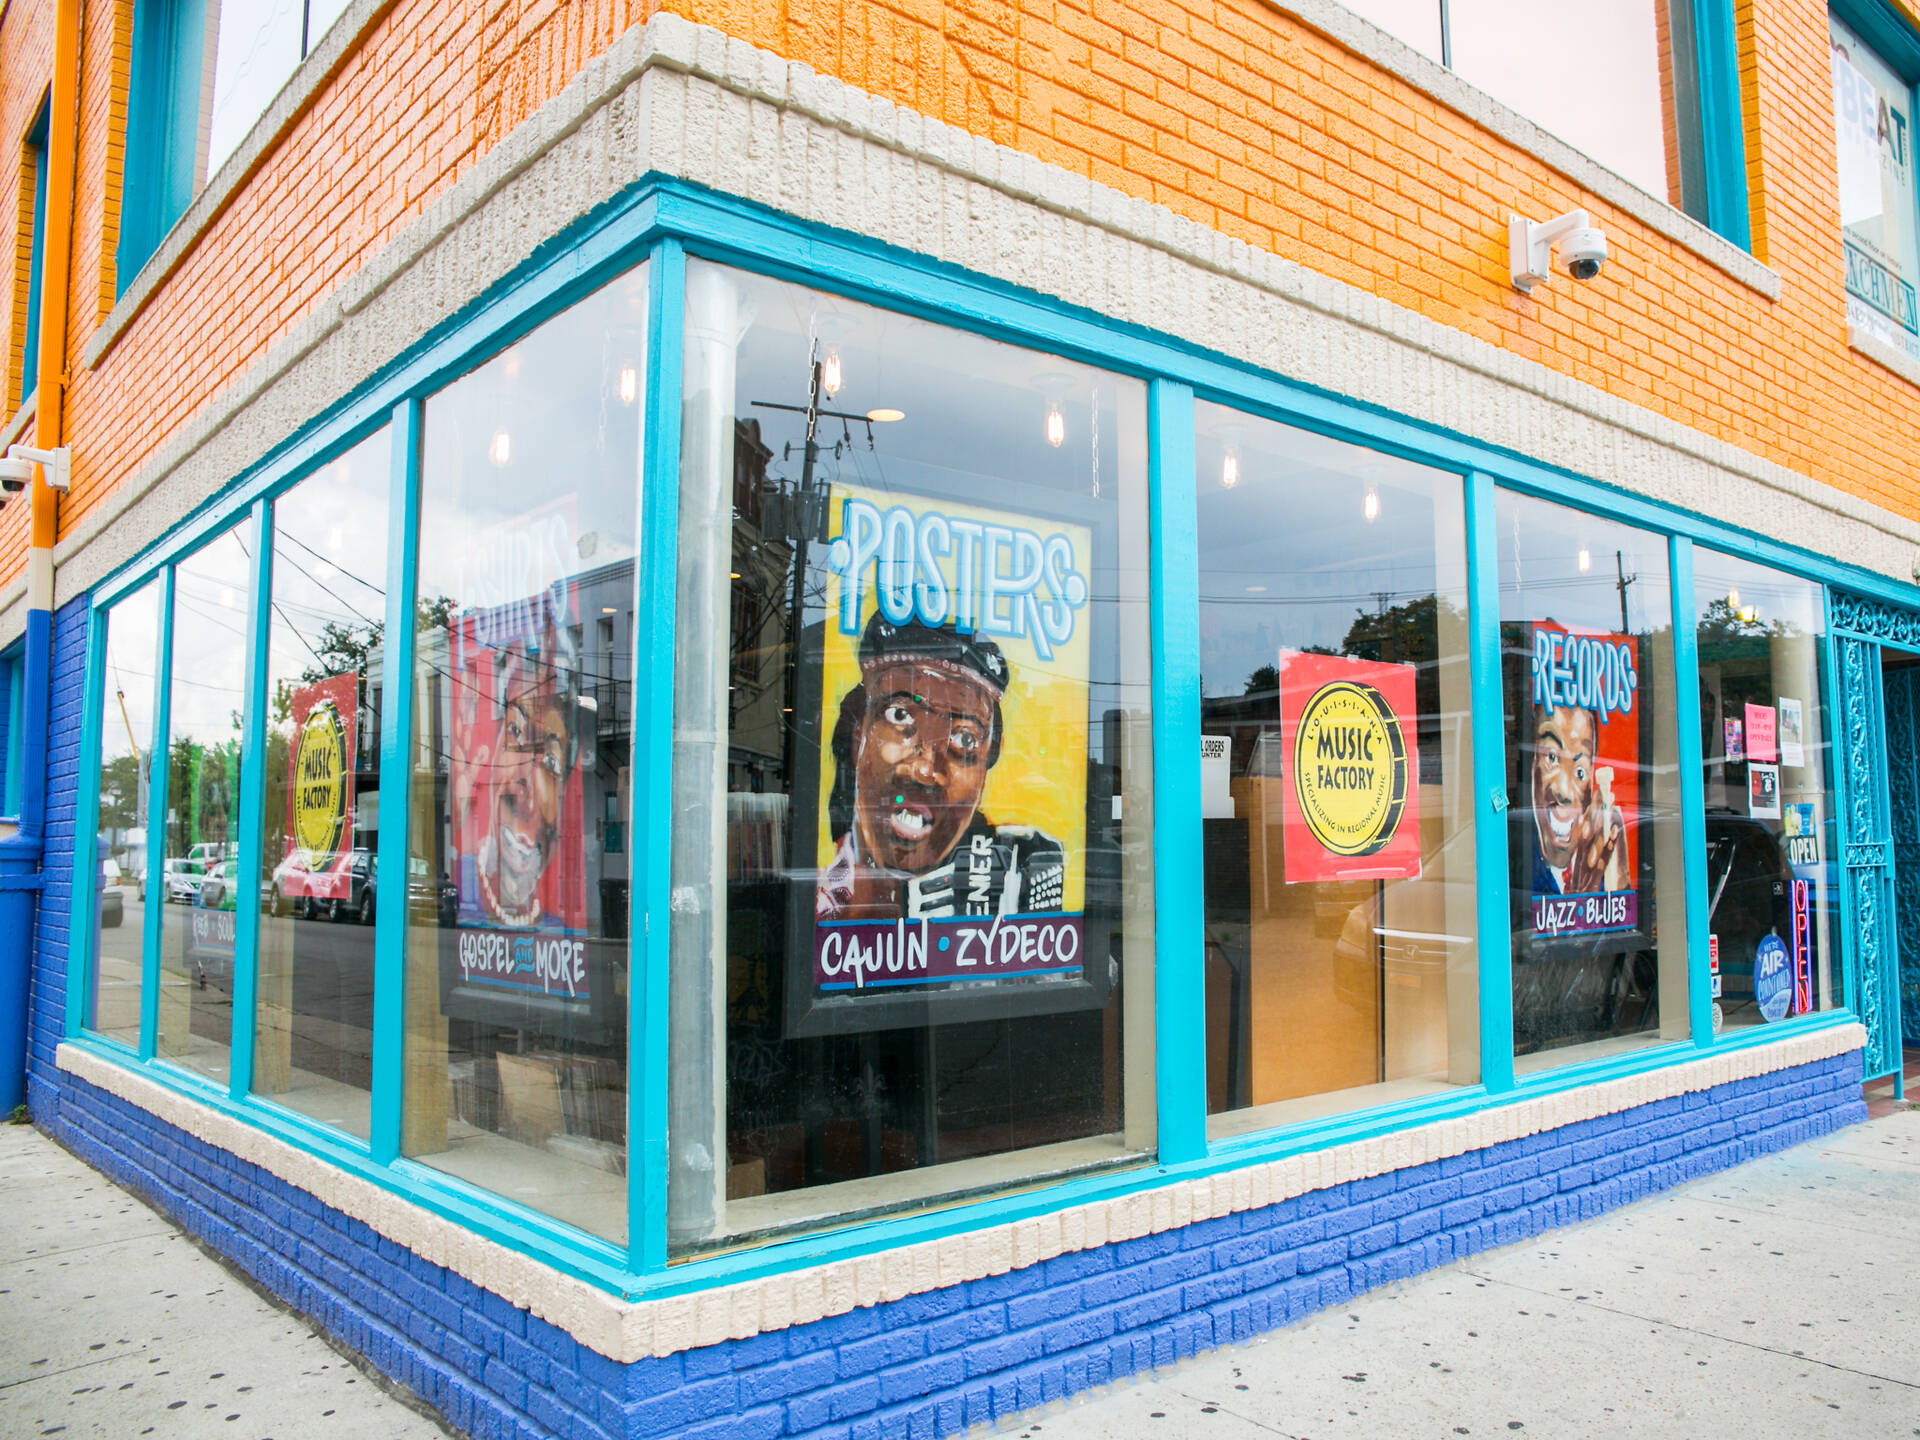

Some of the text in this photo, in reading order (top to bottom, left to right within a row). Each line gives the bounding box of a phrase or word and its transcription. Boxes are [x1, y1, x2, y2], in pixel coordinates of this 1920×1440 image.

[837, 496, 1078, 662] POSTERS
[1534, 628, 1633, 726] RECORDS
[1205, 740, 1224, 752] ORDERS
[1317, 725, 1374, 761] MUSIC
[304, 747, 331, 781] MUSIC
[1317, 764, 1375, 790] FACTORY
[303, 785, 331, 810] FACTORY
[1304, 772, 1386, 834] SPECIALIZING IN REGIONAL MUSIC
[1790, 837, 1818, 865] OPEN
[1536, 890, 1627, 937] JAZZ BLUES
[459, 931, 586, 997] GOSPEL AND MORE
[820, 914, 1079, 989] CAJUN ZYDECO
[1760, 949, 1785, 978] AIR
[1794, 879, 1809, 1014] OPEN
